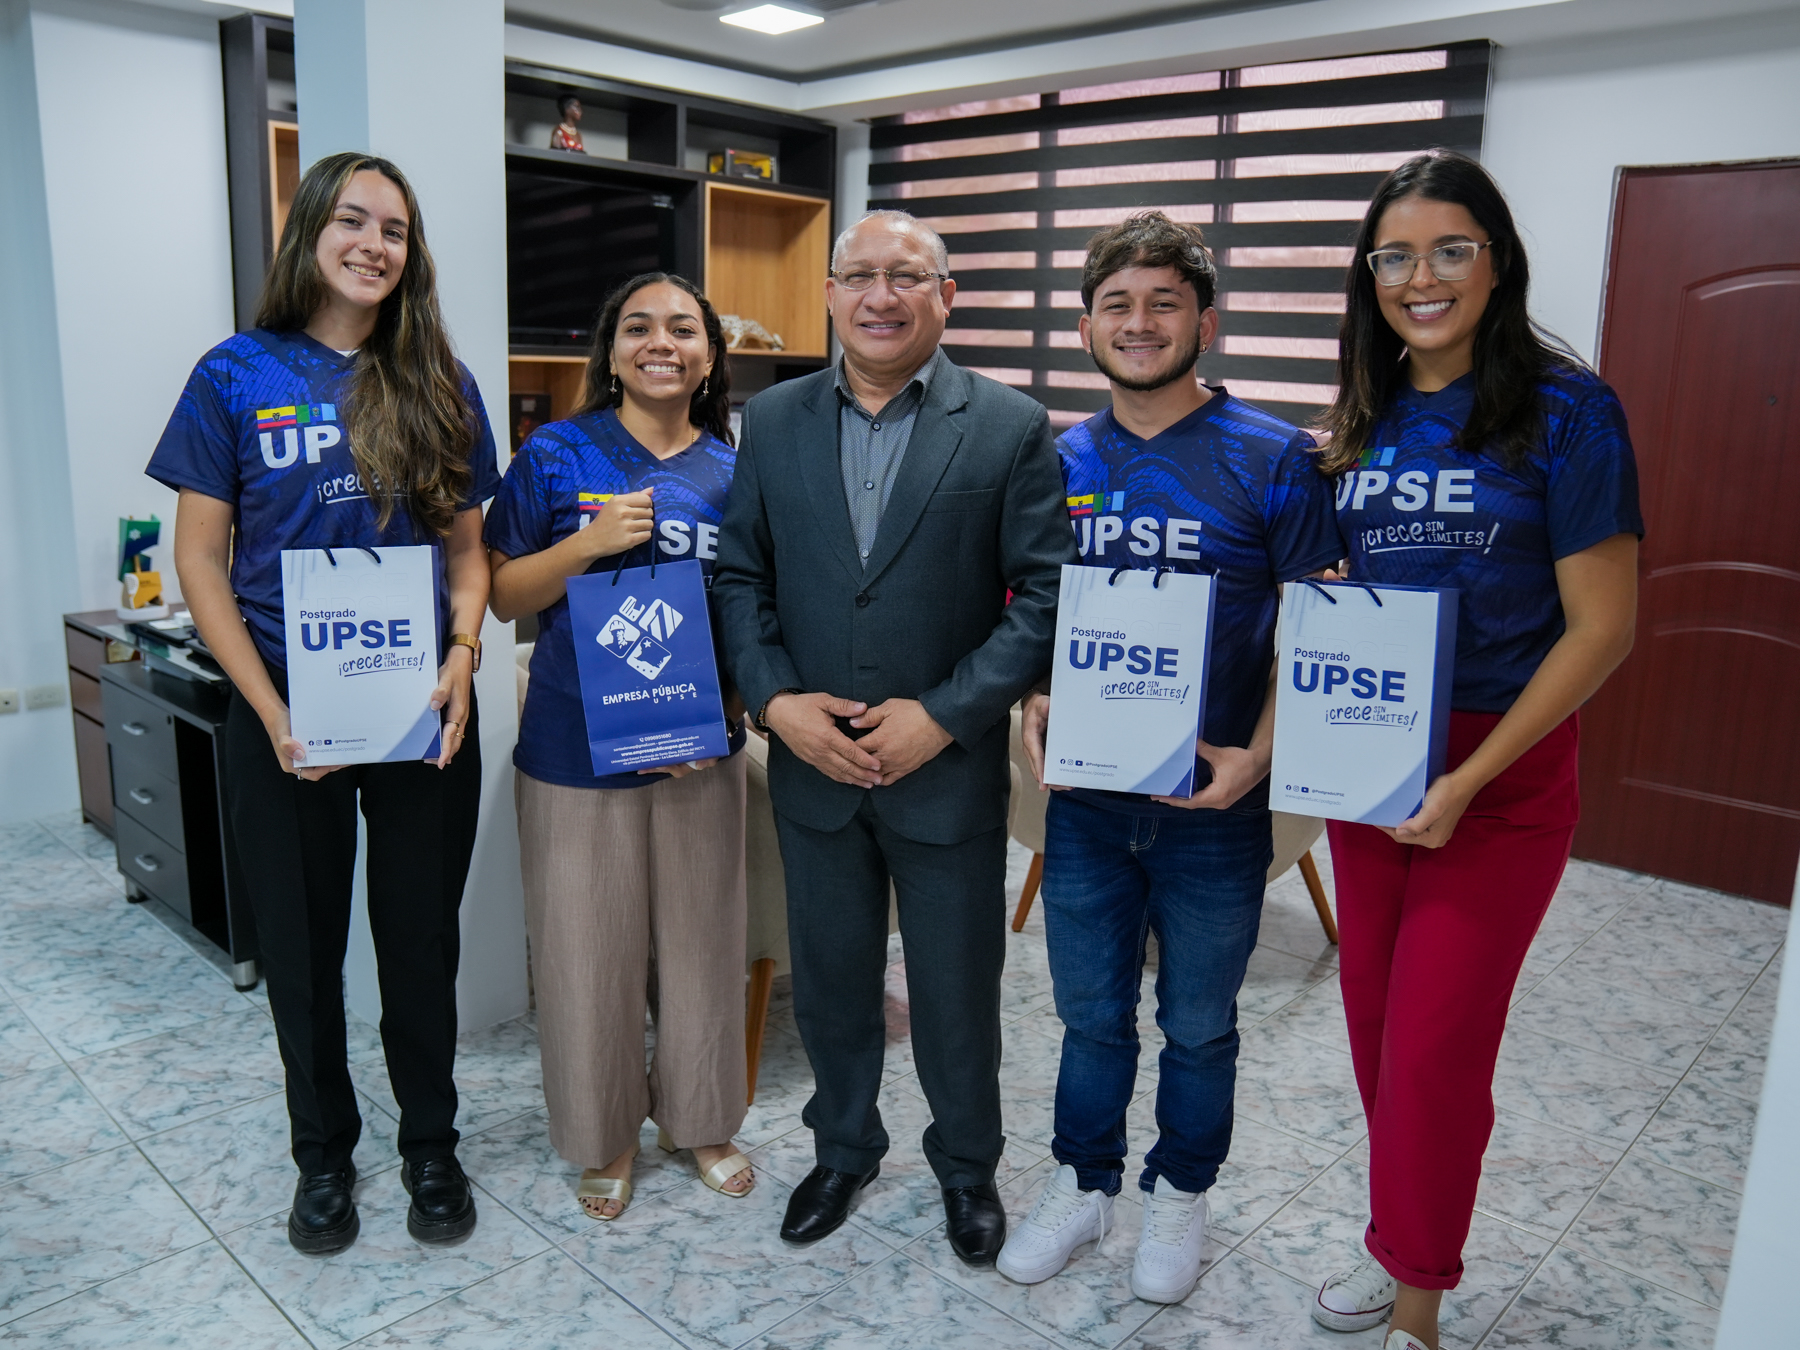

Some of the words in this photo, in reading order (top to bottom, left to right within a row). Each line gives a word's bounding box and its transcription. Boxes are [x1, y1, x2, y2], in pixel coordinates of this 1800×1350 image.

[1336, 469, 1475, 513] UPSE
[1071, 515, 1202, 561] UPSE
[1361, 521, 1424, 551] ¡crece
[1425, 521, 1444, 532] SIN
[300, 608, 356, 620] Postgrado
[300, 619, 412, 652] UPSE
[1071, 626, 1126, 640] Postgrado
[338, 653, 383, 676] ¡crece
[384, 652, 396, 660] SIN
[1069, 639, 1179, 678] UPSE
[1294, 647, 1351, 662] Postgrado
[602, 689, 650, 705] EMPRESA
[652, 682, 696, 697] PÚBLICA
[1100, 680, 1146, 698] ¡crece
[1292, 661, 1406, 703] UPSE
[1325, 705, 1372, 723] ¡crece
